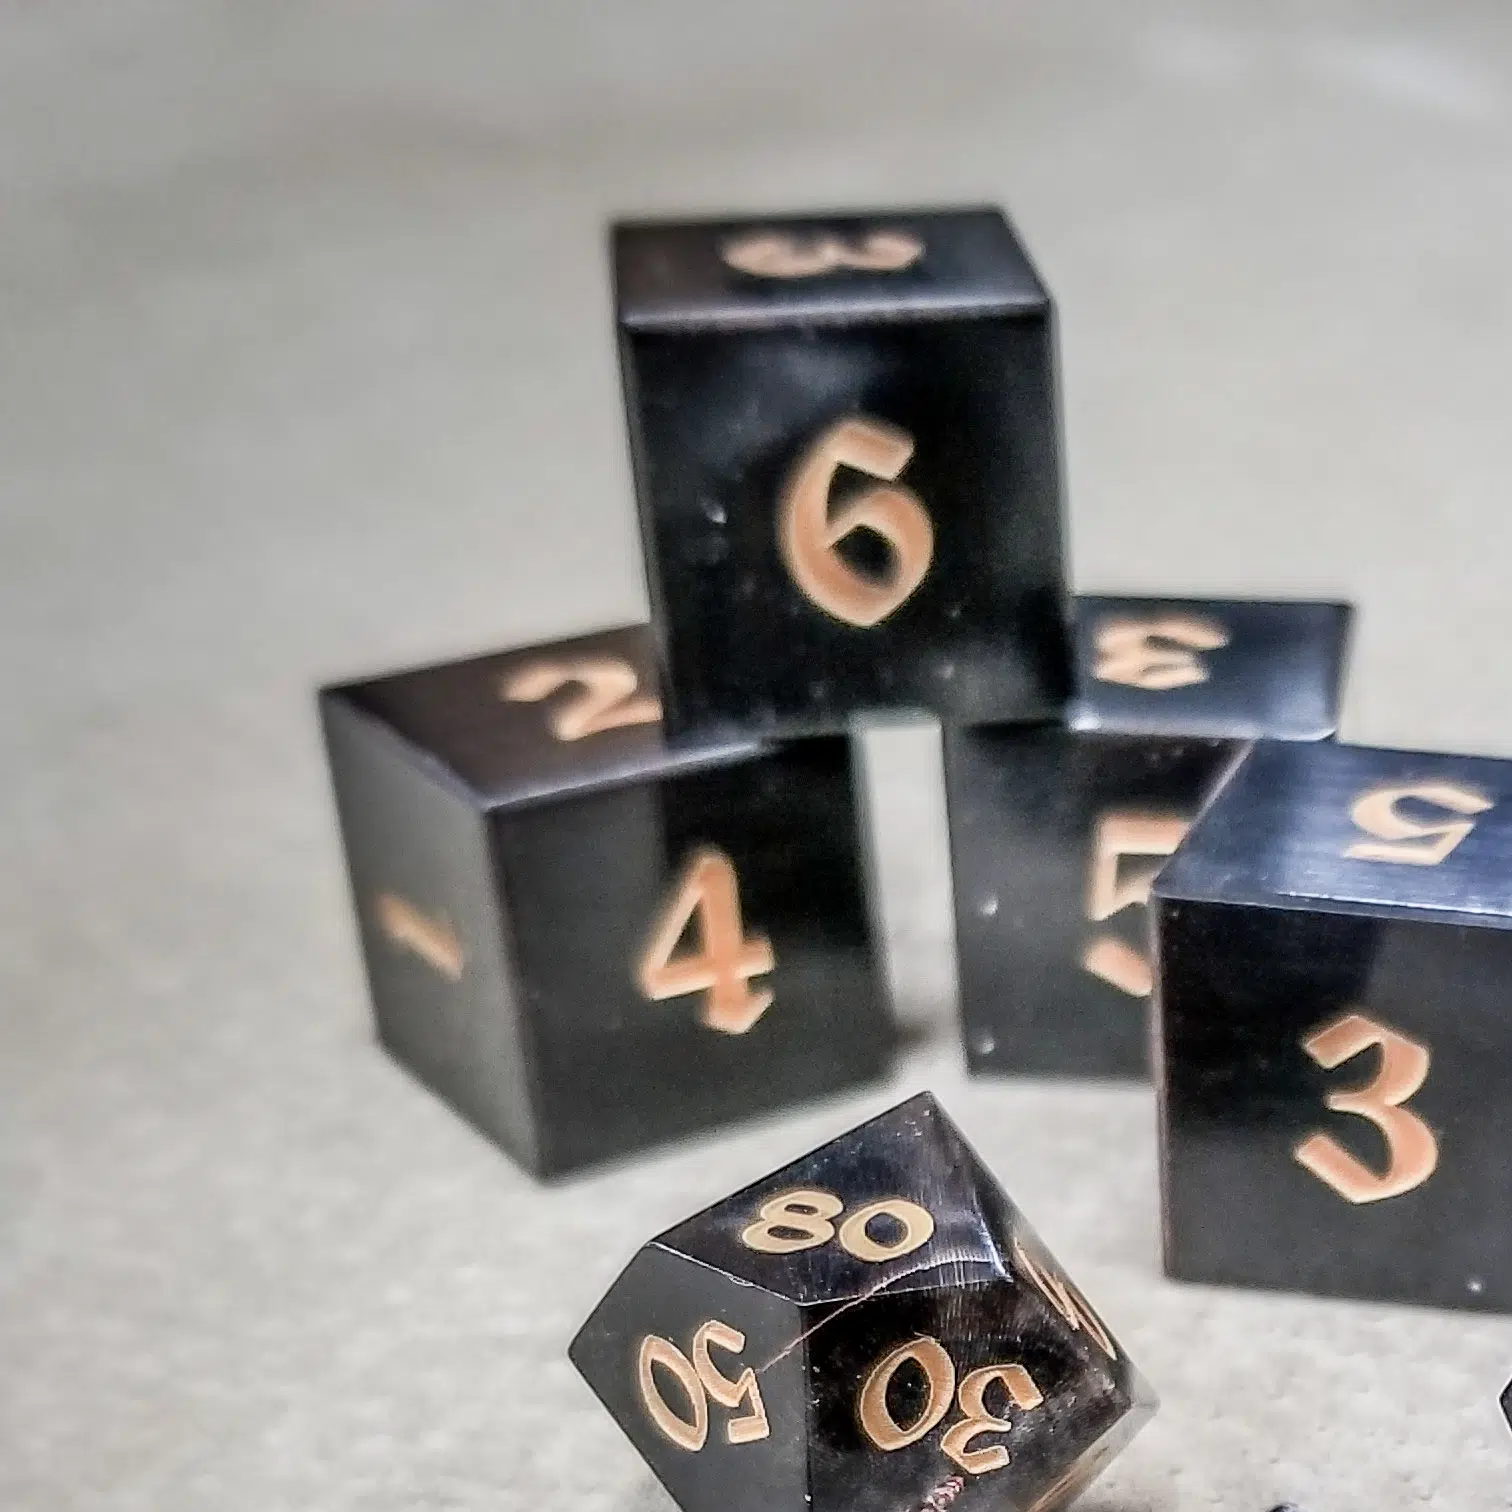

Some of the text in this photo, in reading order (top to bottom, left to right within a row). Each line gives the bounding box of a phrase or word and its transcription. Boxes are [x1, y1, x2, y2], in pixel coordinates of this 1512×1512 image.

[779, 412, 936, 628] 6
[503, 655, 664, 742] 2
[1092, 610, 1230, 690] 3
[1338, 778, 1494, 866] 5
[638, 843, 776, 1035] 4
[1294, 1013, 1440, 1205] 3
[741, 1189, 936, 1263] 80
[637, 1319, 772, 1453] 50
[859, 1332, 1045, 1476] 30
